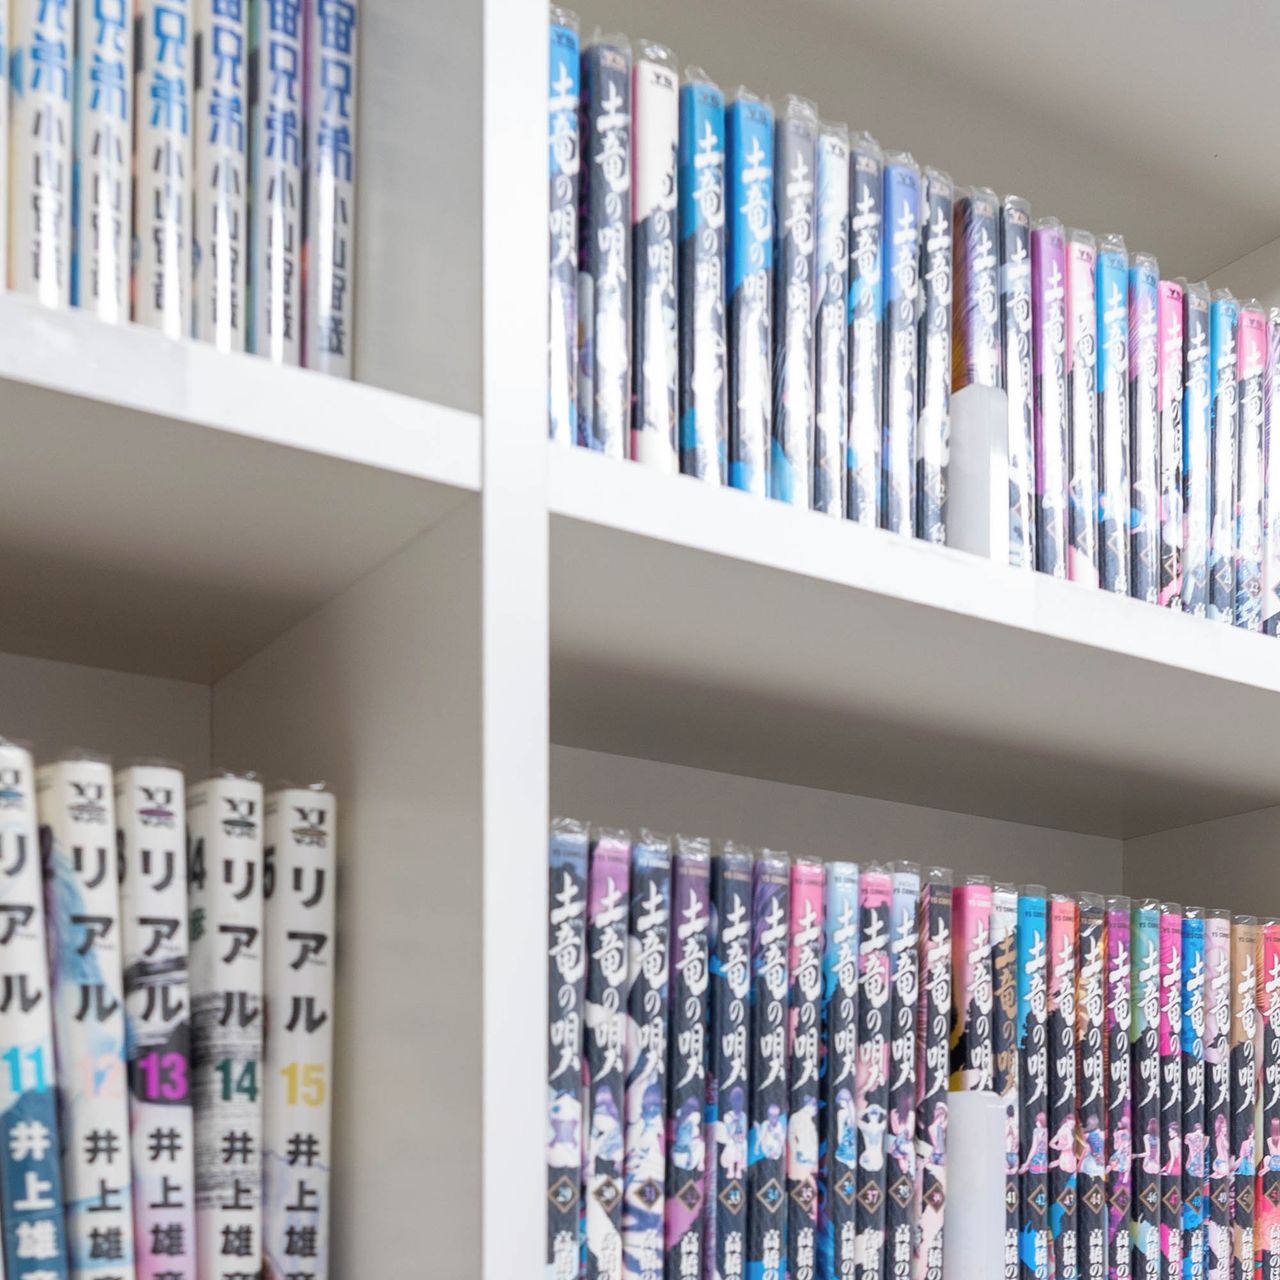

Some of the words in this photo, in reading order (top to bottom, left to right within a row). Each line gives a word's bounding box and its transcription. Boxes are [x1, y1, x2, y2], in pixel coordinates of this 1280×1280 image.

[73, 846, 119, 1024] リアル
[139, 849, 185, 1024] リアル
[221, 860, 261, 1030] リアル
[286, 867, 327, 1034] リアル
[1, 1048, 48, 1095] 11
[138, 1053, 187, 1102] 13
[216, 1059, 258, 1106] 14
[280, 1063, 325, 1107] 15
